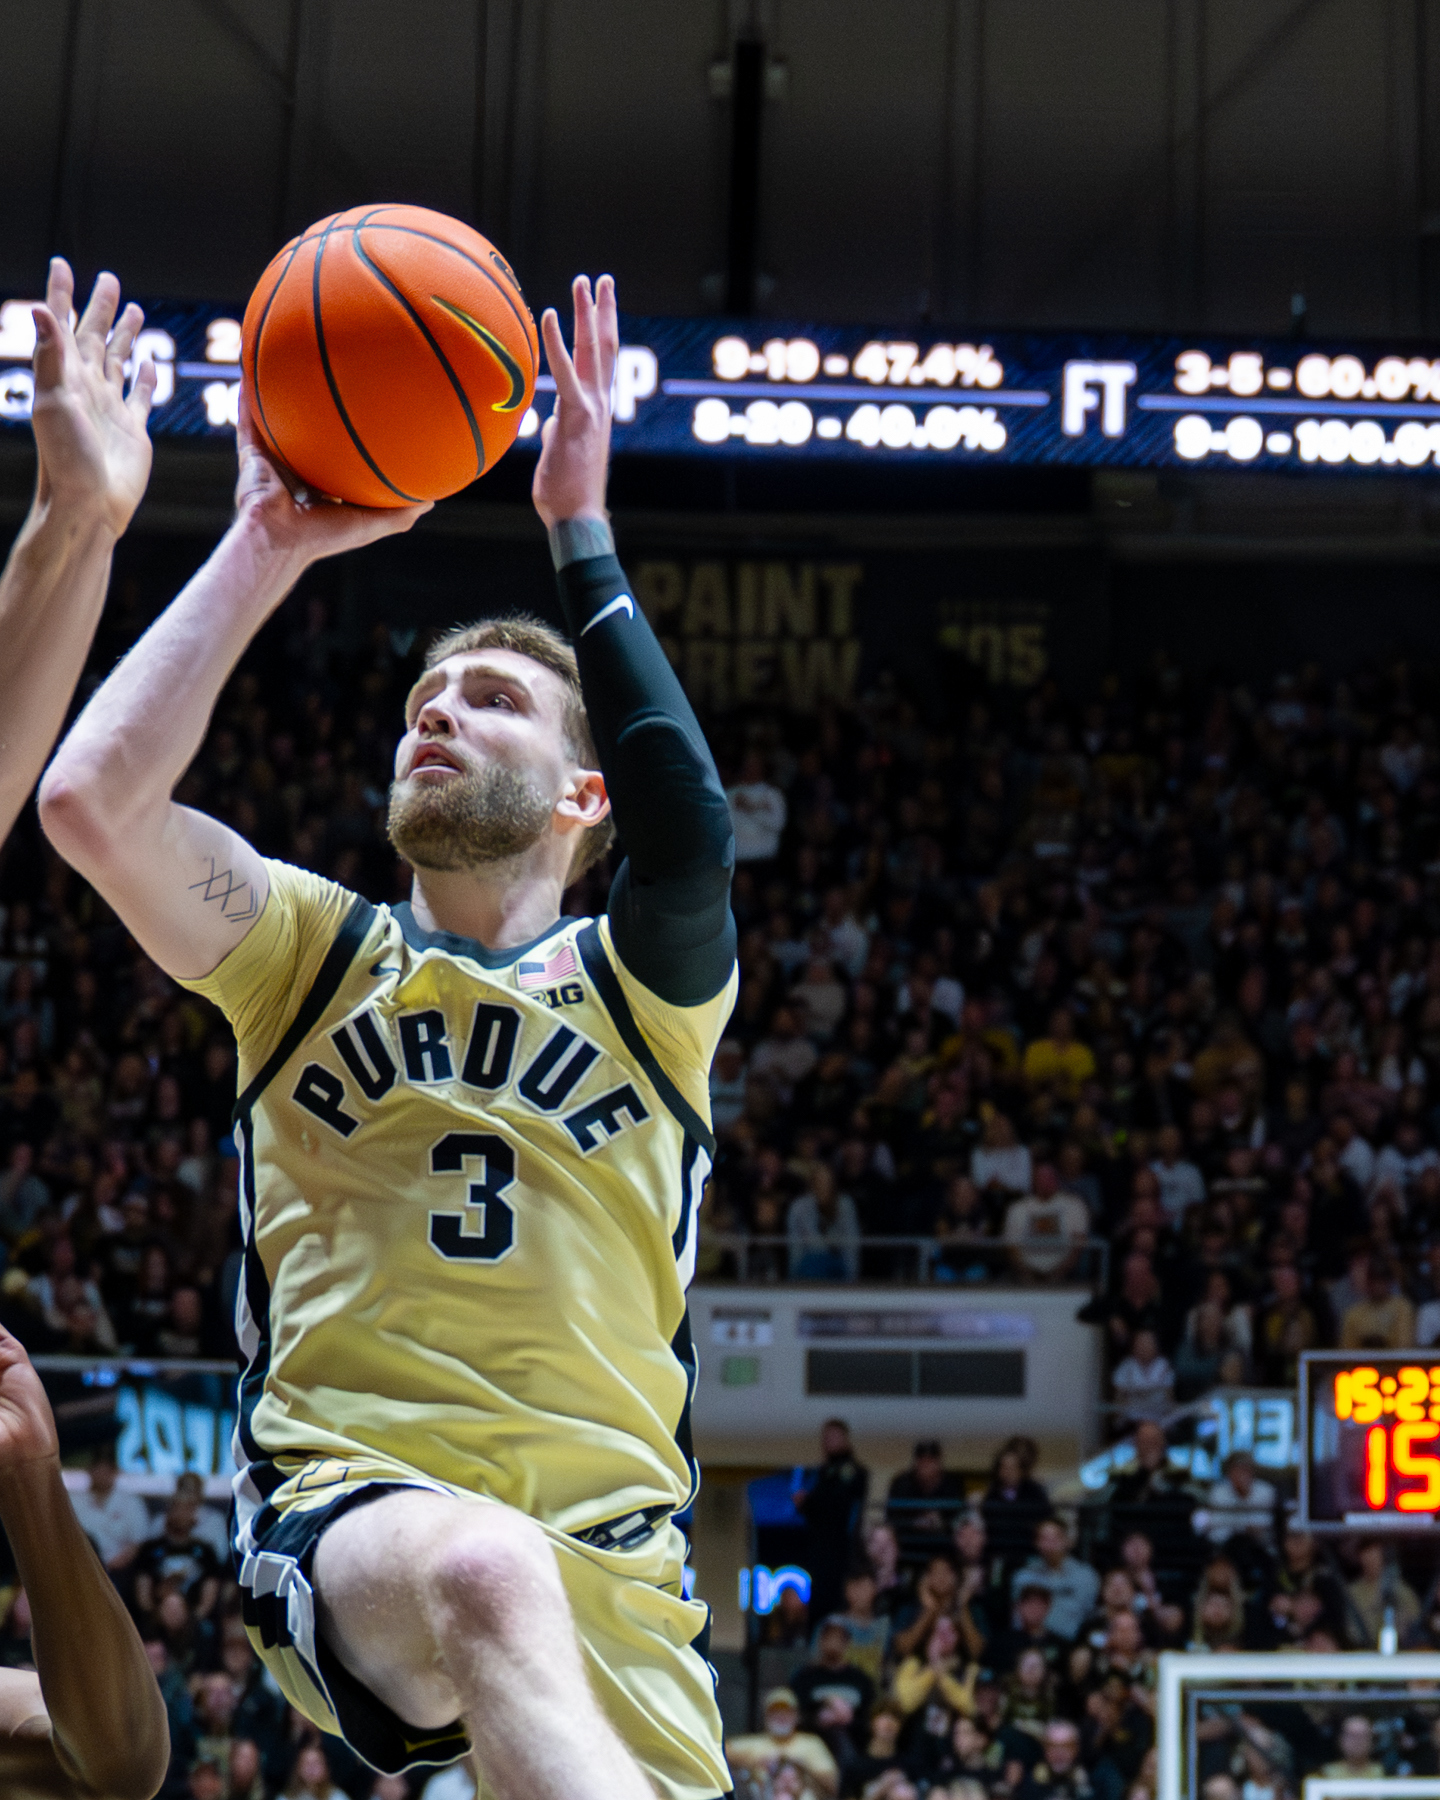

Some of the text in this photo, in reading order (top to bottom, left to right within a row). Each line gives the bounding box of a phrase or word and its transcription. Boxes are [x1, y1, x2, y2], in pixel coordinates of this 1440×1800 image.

[1062, 360, 1138, 437] FT
[633, 560, 862, 635] PAINT
[662, 635, 860, 714] REW
[291, 1001, 652, 1159] PURDUE
[427, 1131, 519, 1265] 3
[1365, 1422, 1440, 1513] 15
